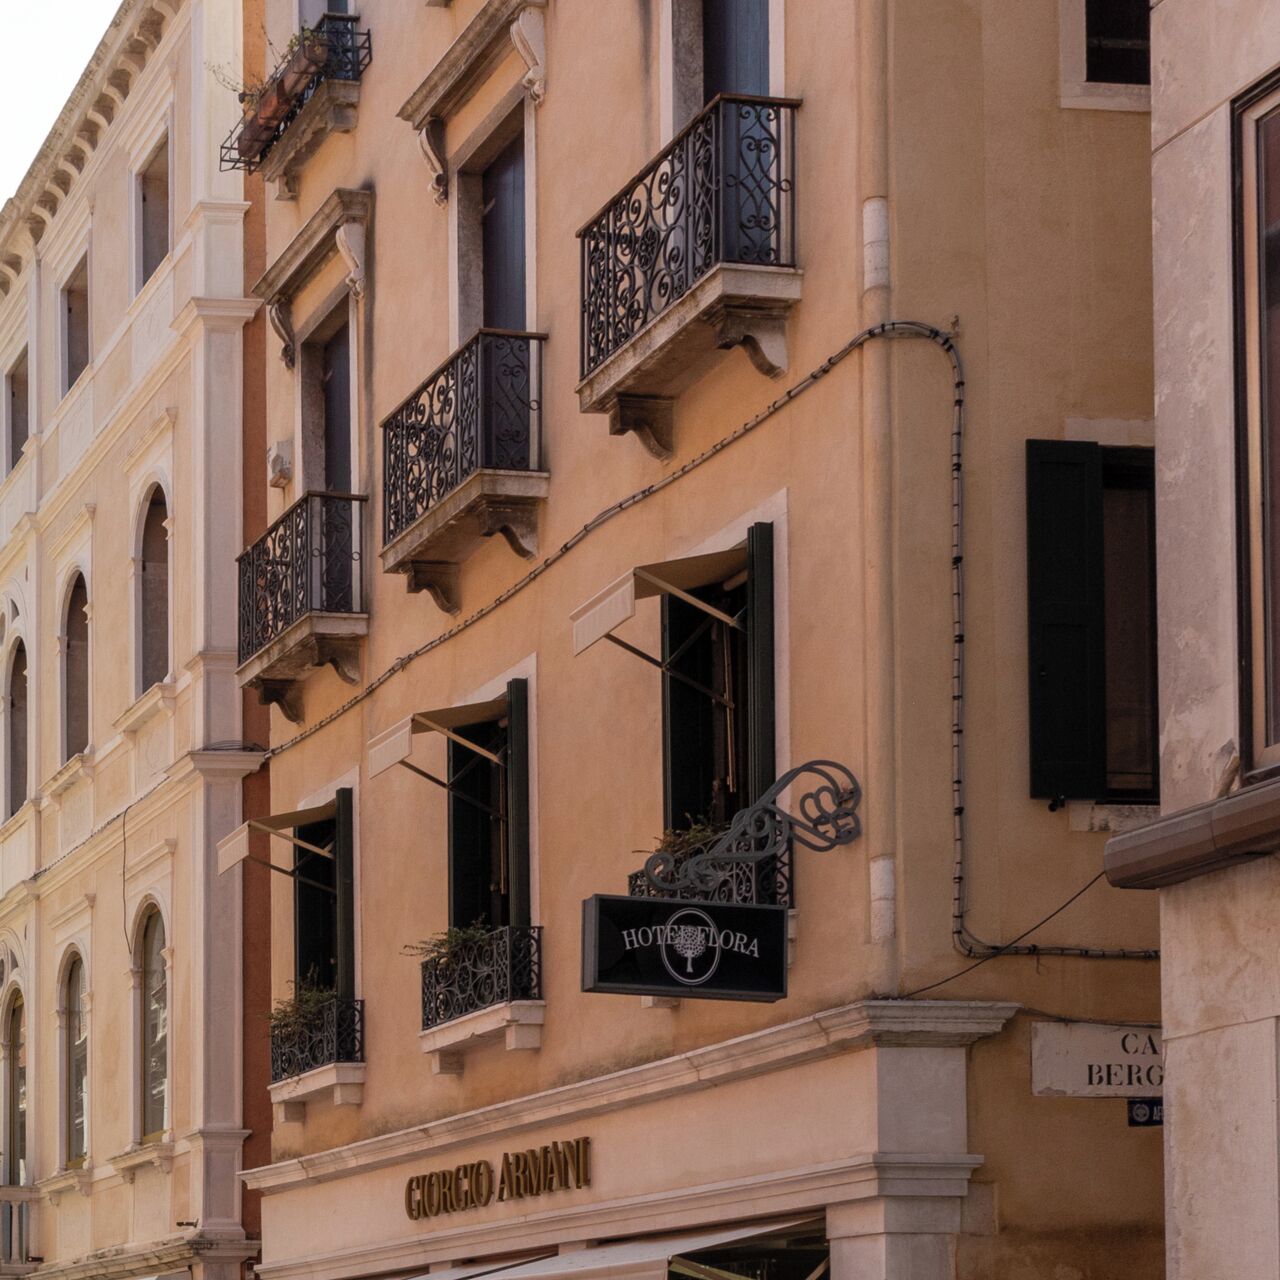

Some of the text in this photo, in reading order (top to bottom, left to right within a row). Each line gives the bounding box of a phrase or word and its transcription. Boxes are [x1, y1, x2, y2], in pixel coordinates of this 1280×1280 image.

[621, 924, 760, 959] HOTEL FLORA
[404, 1136, 593, 1221] GIORGIO ARMANI
